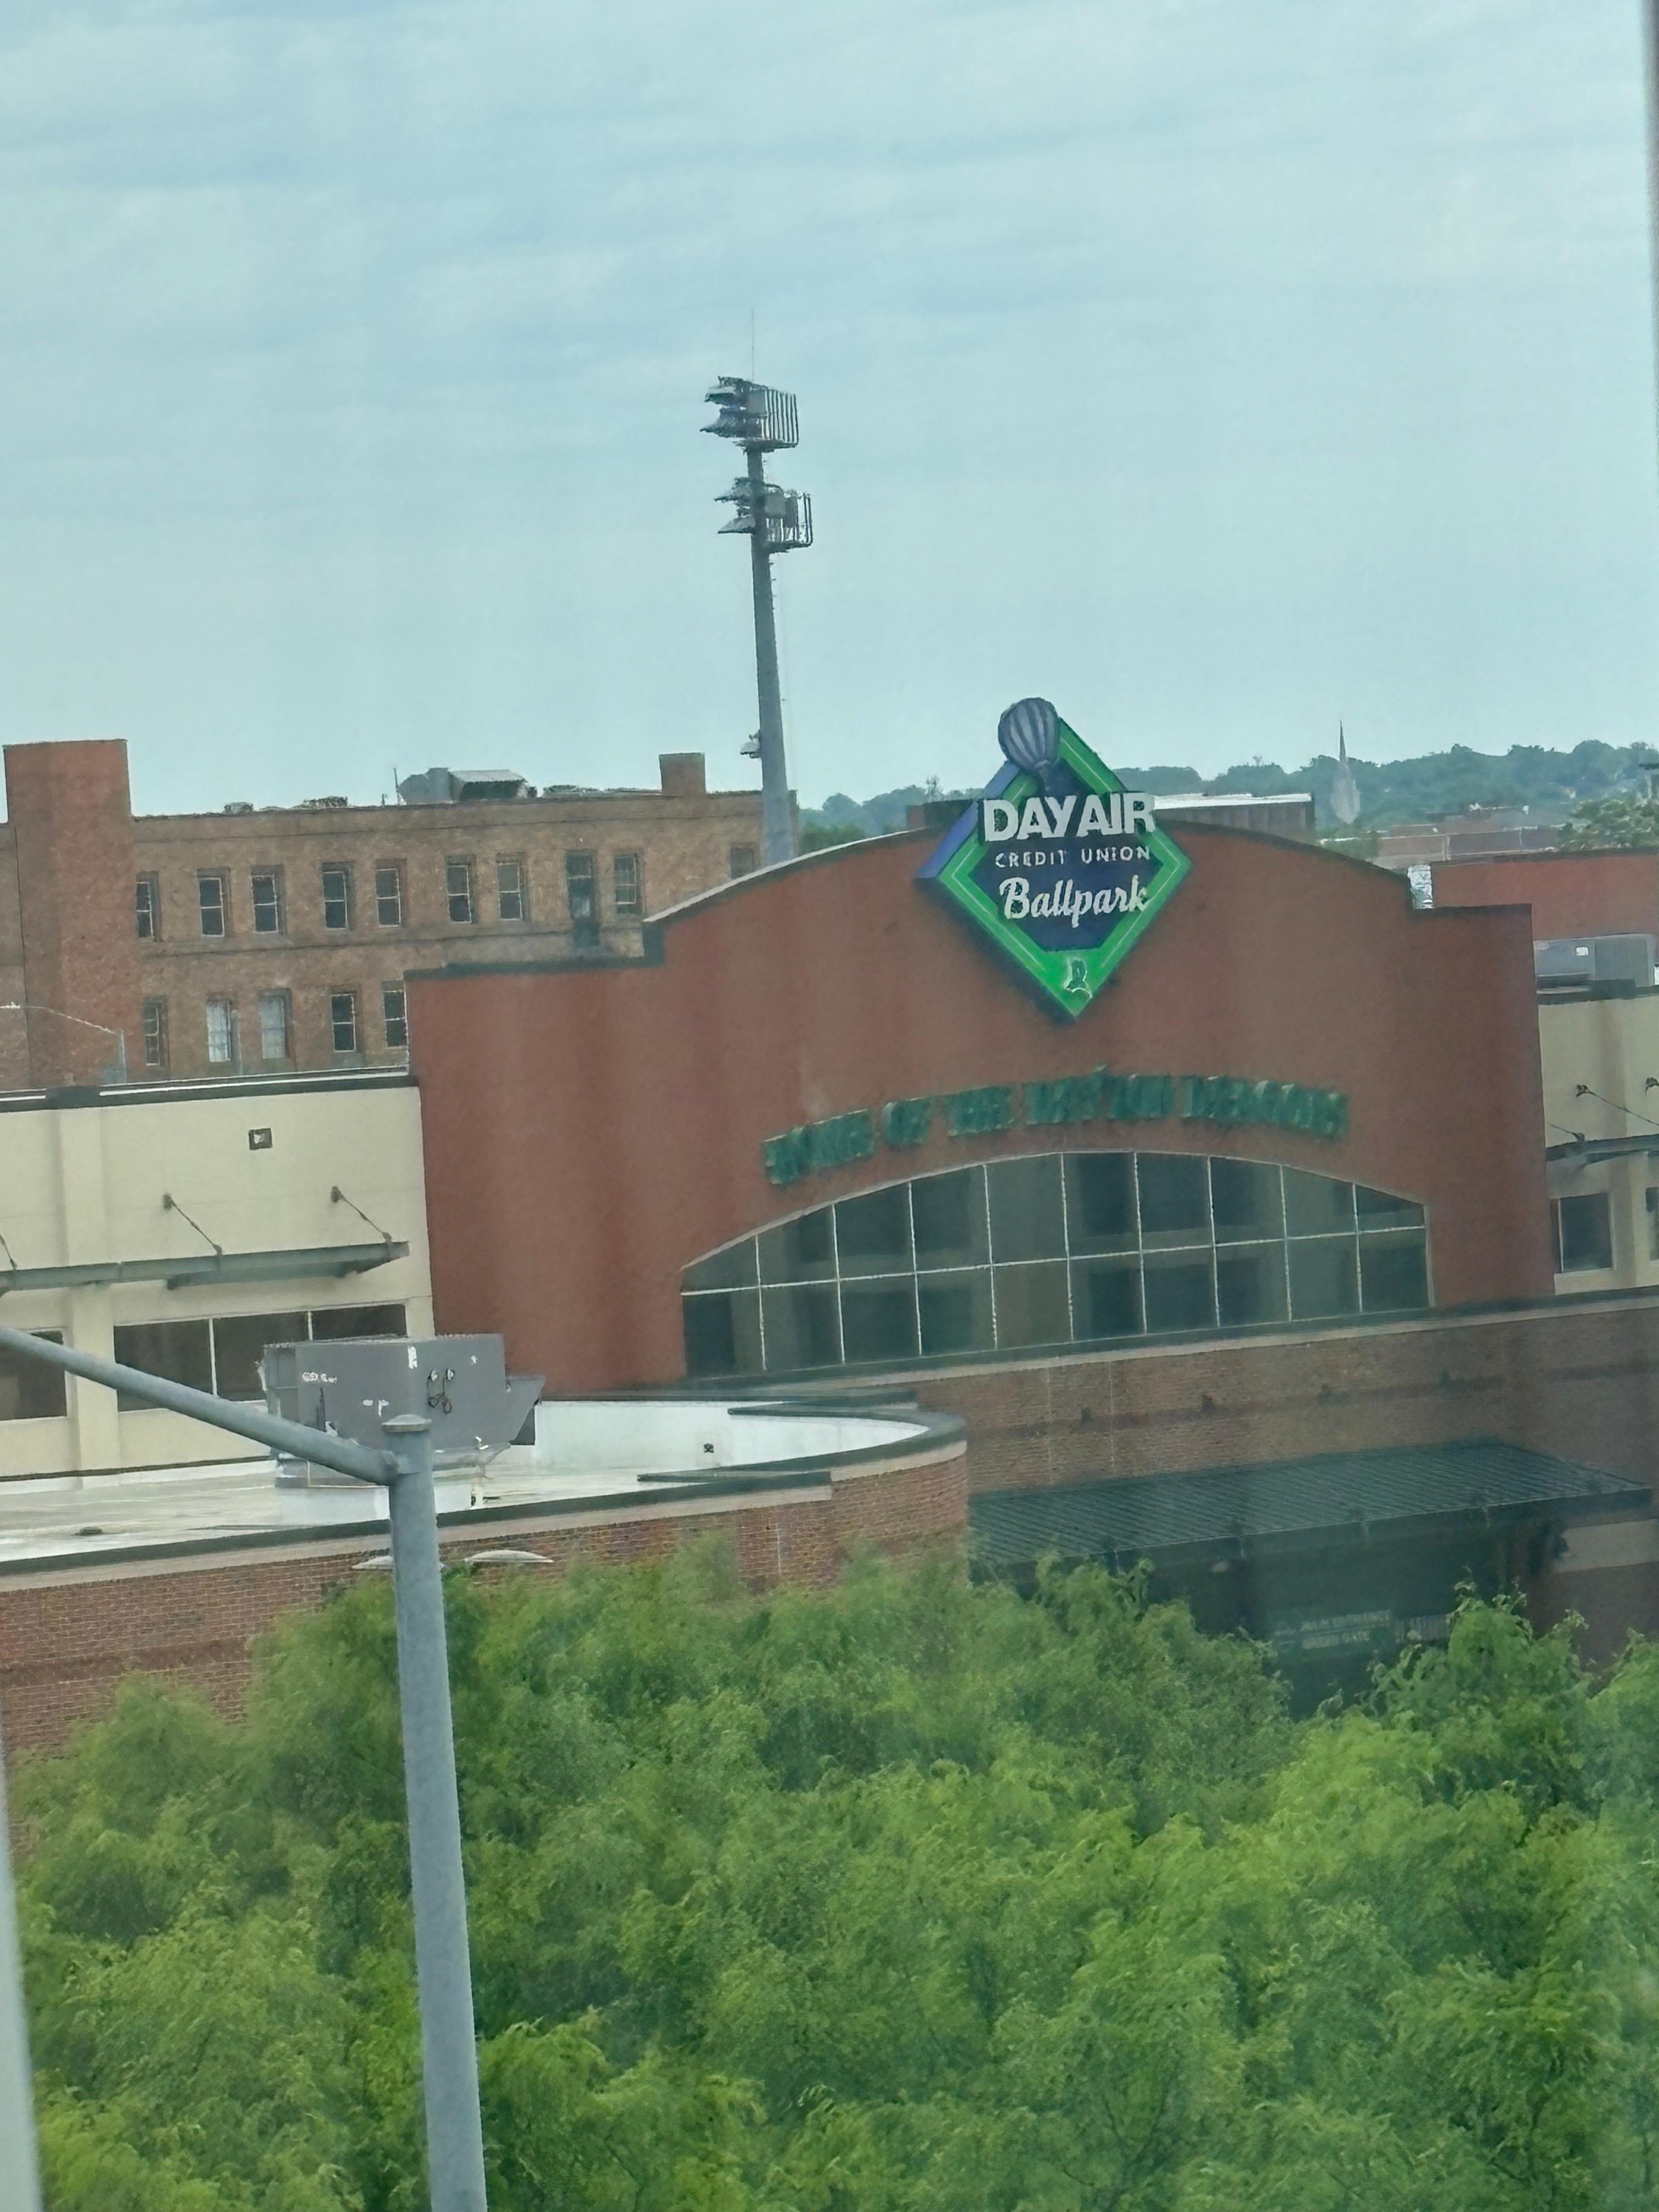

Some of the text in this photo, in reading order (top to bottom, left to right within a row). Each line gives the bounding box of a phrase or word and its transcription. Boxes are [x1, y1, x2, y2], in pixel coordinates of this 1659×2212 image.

[995, 846, 1150, 868] CREDIT UNION
[999, 874, 1153, 928] Ballpark
